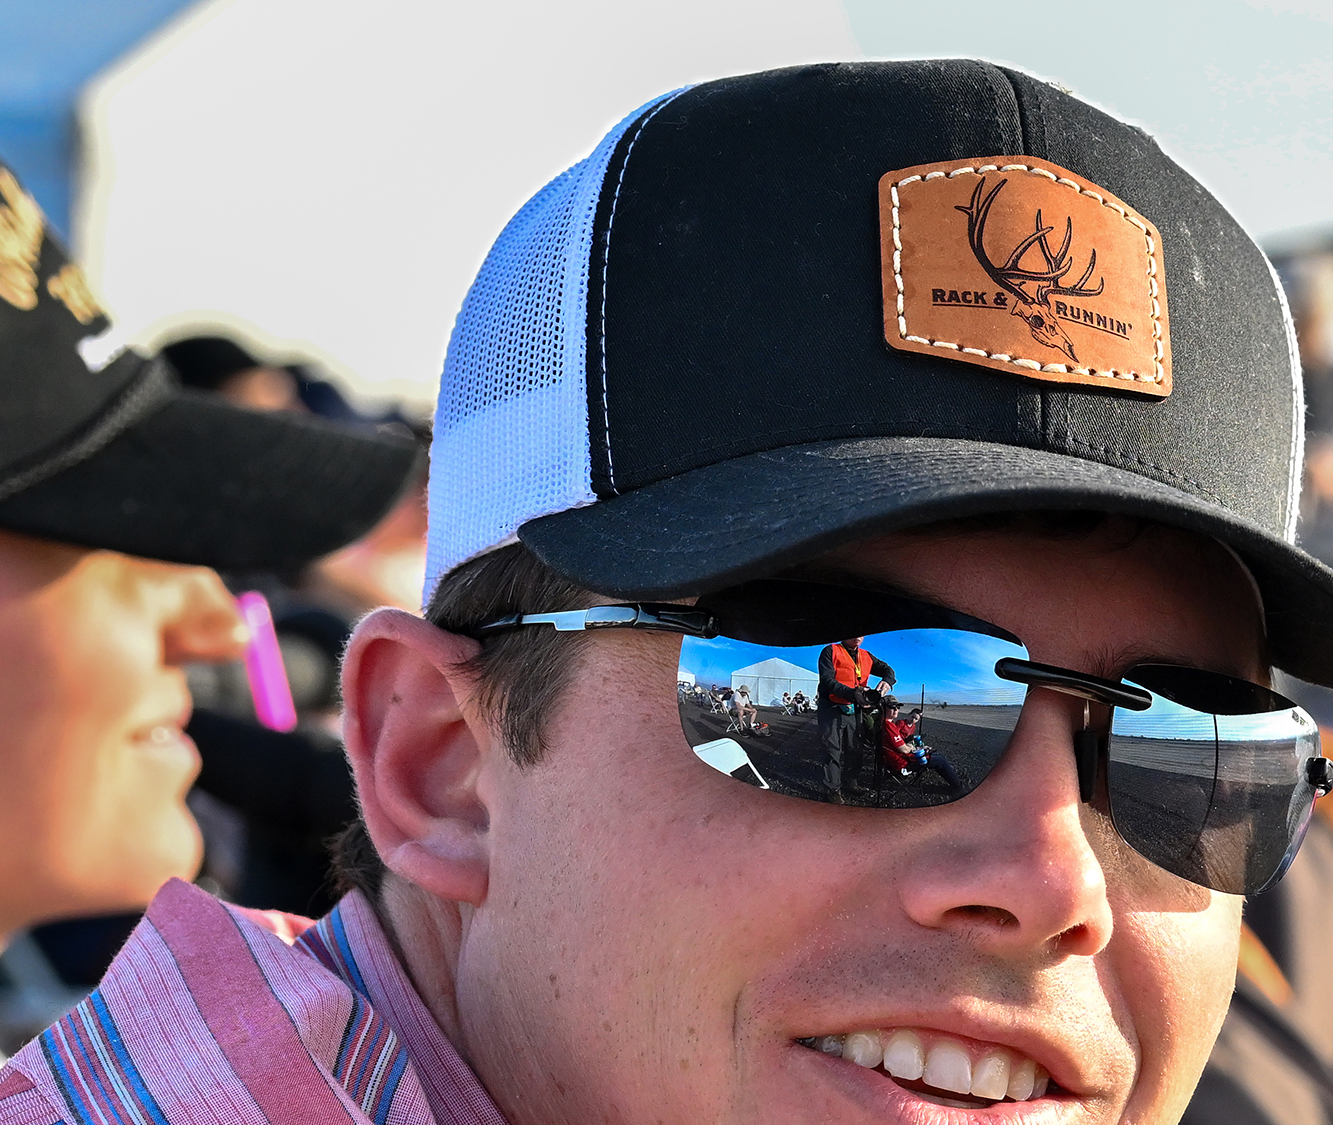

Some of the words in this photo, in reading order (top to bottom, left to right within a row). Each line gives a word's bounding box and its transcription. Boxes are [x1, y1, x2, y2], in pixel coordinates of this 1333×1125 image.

[932, 288, 988, 305] RACK
[993, 291, 1008, 307] &
[1055, 300, 1133, 336] RUNNIN'
